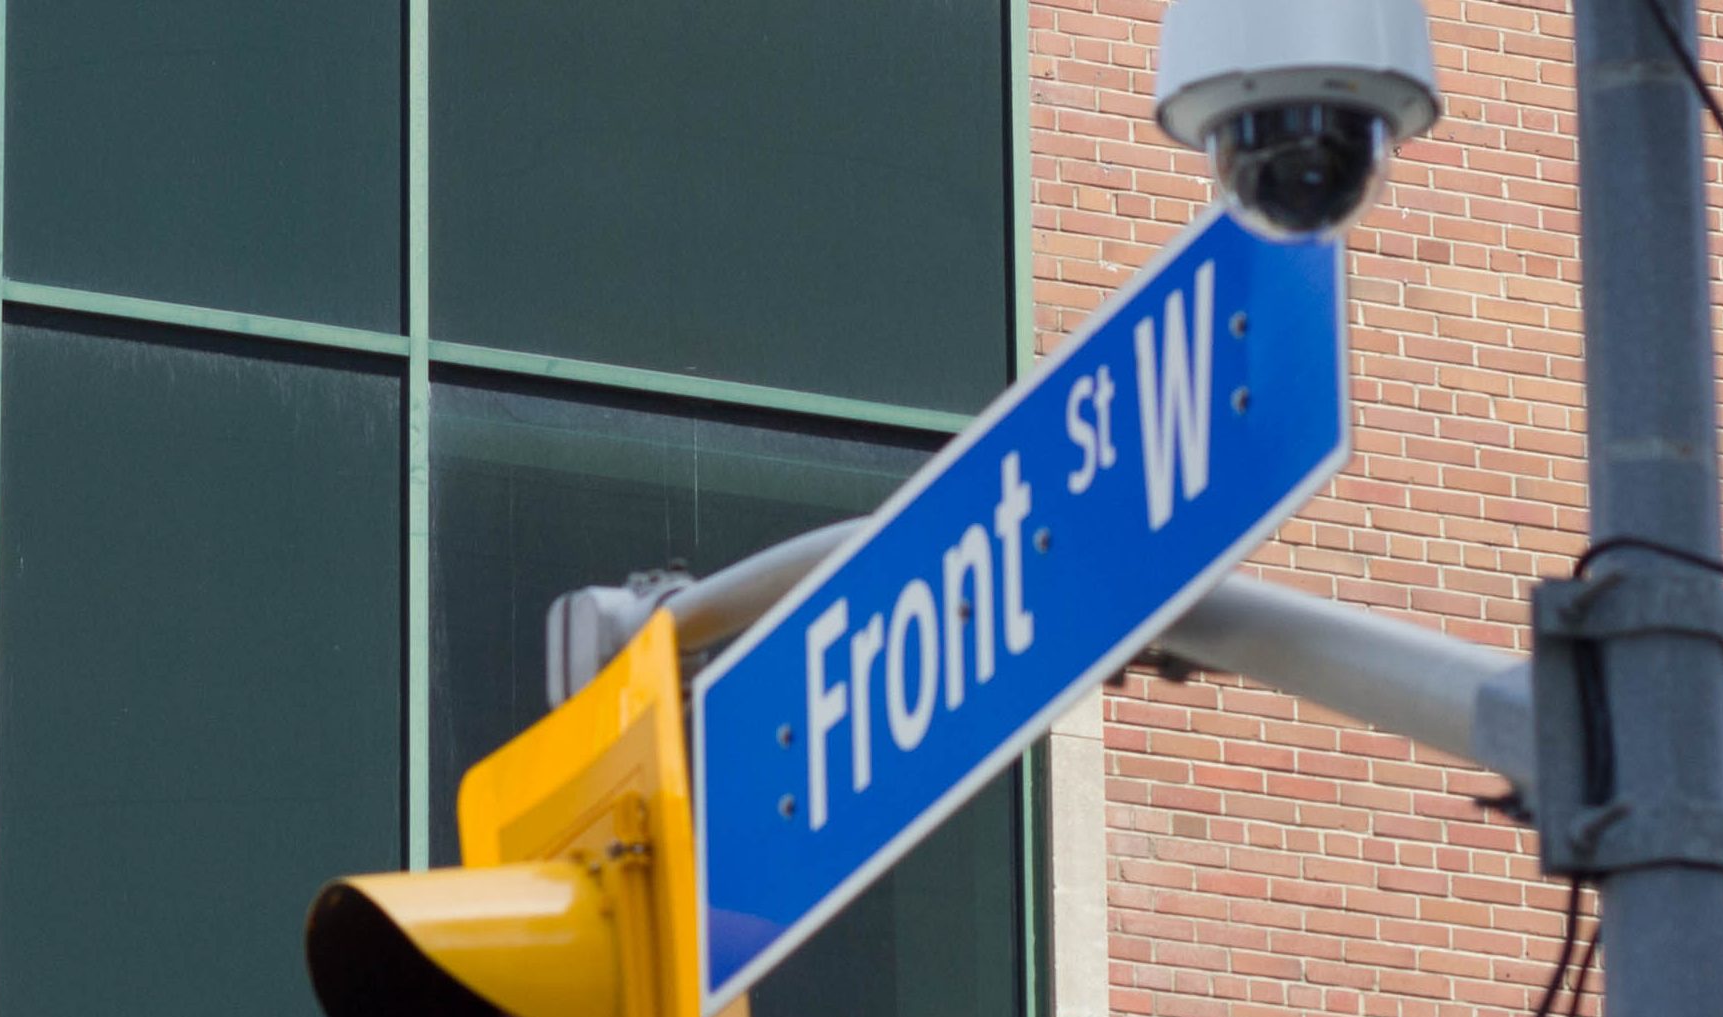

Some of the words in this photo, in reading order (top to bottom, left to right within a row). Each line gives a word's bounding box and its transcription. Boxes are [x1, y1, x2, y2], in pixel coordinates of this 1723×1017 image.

[805, 450, 1035, 831] Front
[1066, 364, 1117, 494] St
[1133, 260, 1215, 531] W
